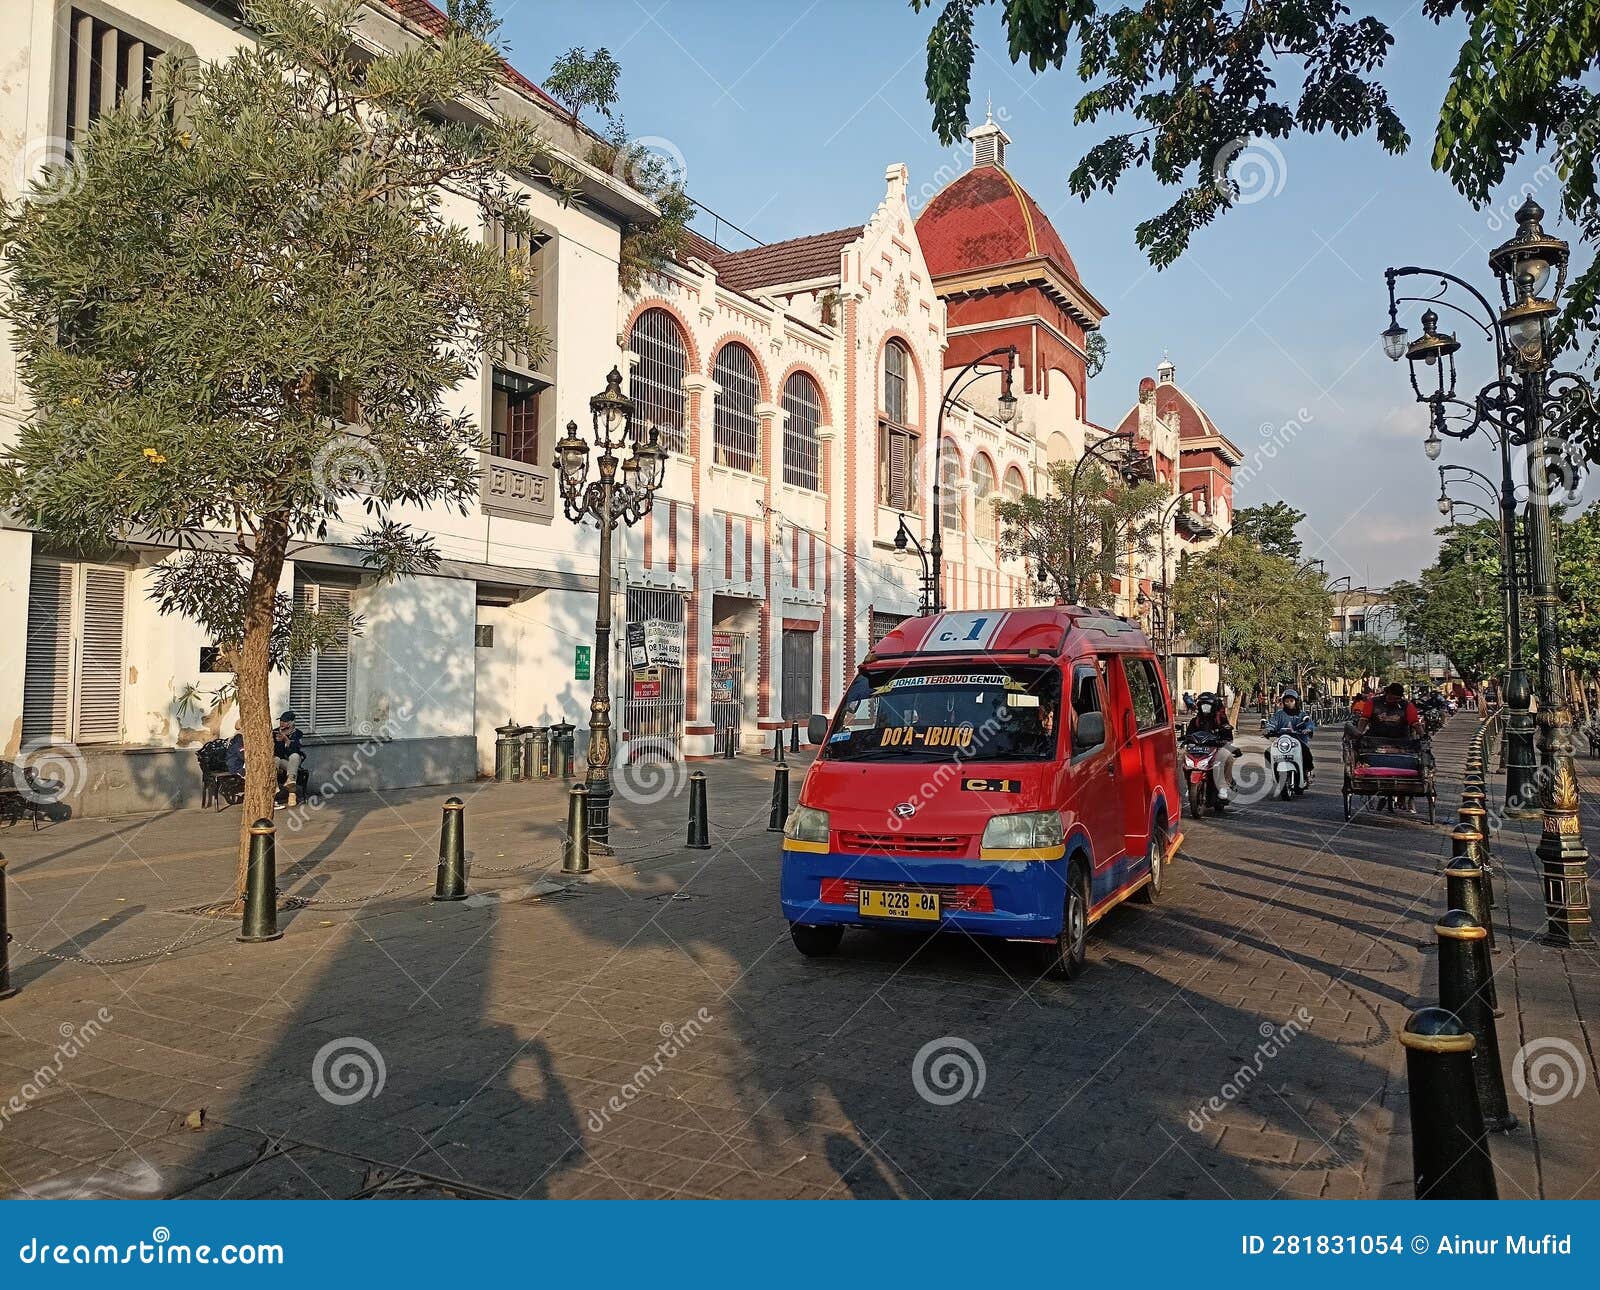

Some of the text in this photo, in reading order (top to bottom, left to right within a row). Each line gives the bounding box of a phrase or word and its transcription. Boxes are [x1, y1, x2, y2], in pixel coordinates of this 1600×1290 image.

[969, 674, 1005, 685] GENUK
[862, 891, 870, 905] H
[881, 892, 909, 908] 1228
